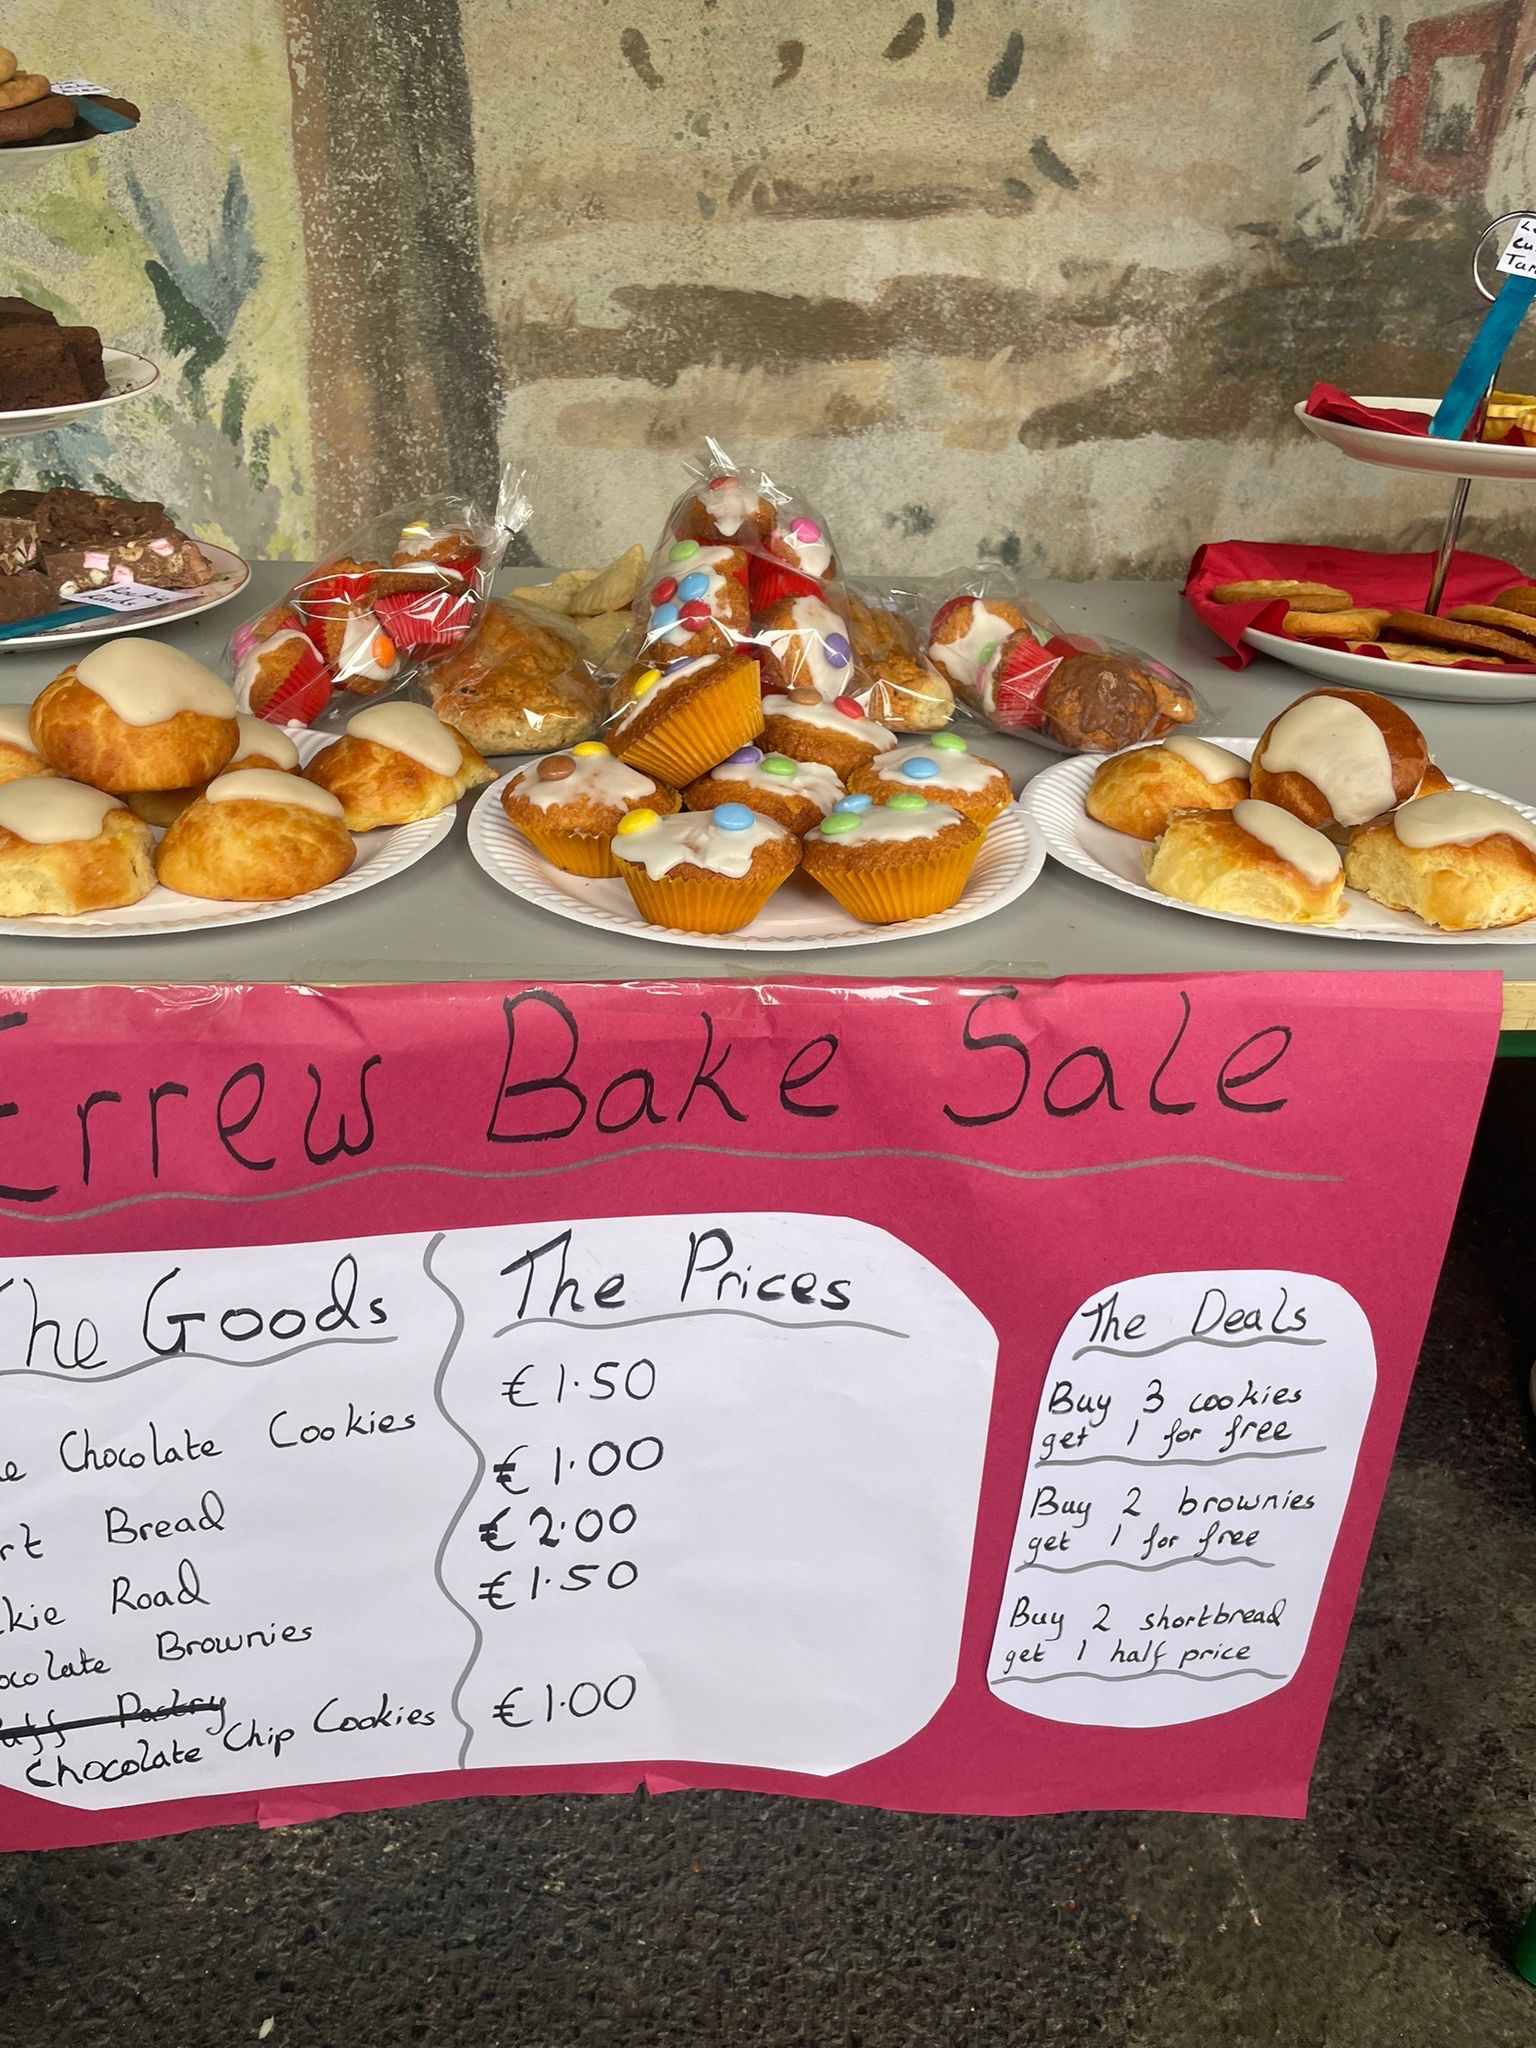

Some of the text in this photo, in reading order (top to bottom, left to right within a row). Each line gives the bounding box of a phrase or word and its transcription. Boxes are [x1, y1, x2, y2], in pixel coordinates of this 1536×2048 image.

[487, 989, 839, 1143] Bake
[944, 986, 1292, 1128] Sale
[500, 1228, 852, 1320] The Prices
[0, 1253, 389, 1370] he Goods
[1081, 1287, 1307, 1343] The Deals
[1048, 1378, 1302, 1428] Buy 3 cookies
[59, 1421, 223, 1473] Chocolate
[269, 1402, 417, 1449] Cookies
[1039, 1414, 1292, 1460] get 1 for free
[104, 1490, 225, 1544] Bread
[1030, 1485, 1315, 1529] Buy 2 brownies
[1027, 1520, 1260, 1566] get 1 for free
[0, 1558, 210, 1635] kie Road
[1009, 1595, 1287, 1641] Buy 2 shortbread
[0, 1623, 313, 1690] ocolate Brownies
[1003, 1639, 1251, 1675] get 1 half price
[25, 1692, 436, 1788] Chocolate Chip Cookies
